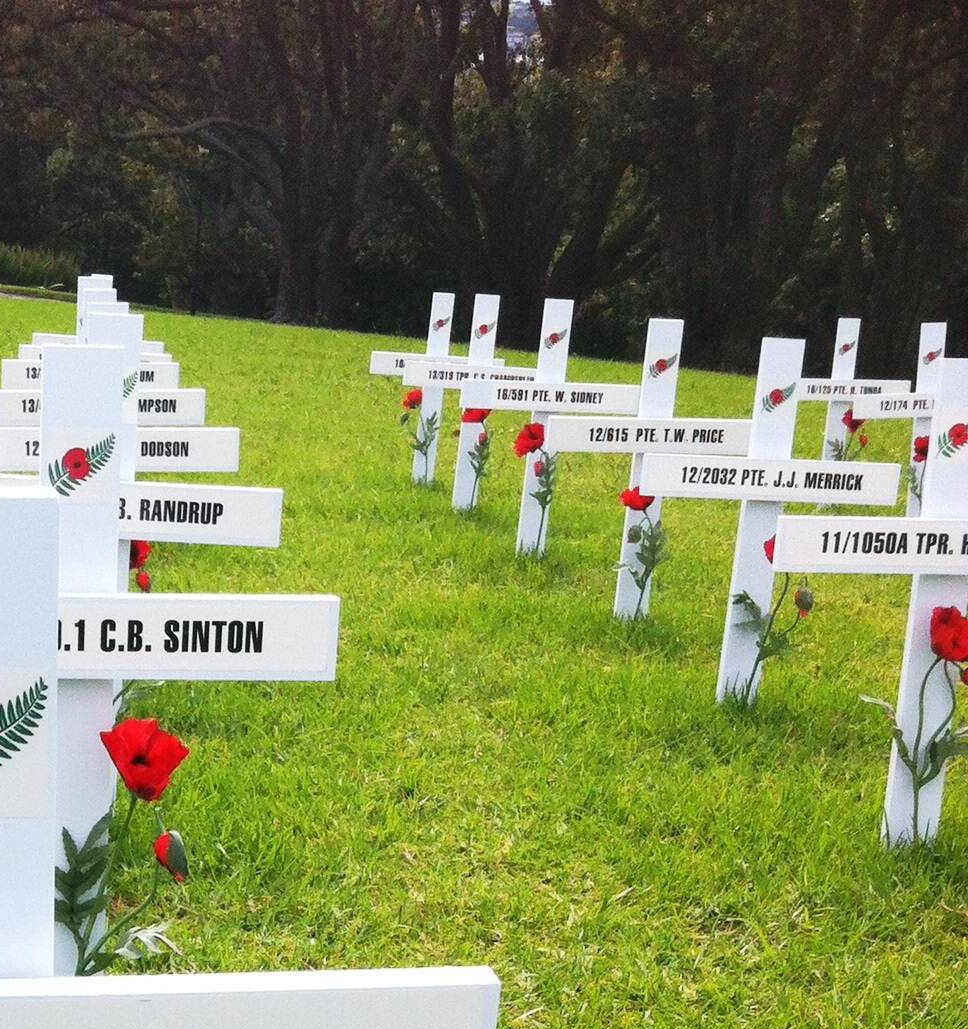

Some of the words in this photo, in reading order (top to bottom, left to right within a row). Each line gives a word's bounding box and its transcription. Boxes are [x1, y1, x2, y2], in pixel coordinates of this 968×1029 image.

[140, 370, 154, 382] UM
[532, 390, 551, 402] PTE.
[555, 391, 566, 403] W.
[570, 392, 604, 404] SIDNEY
[138, 398, 177, 414] MPSON
[880, 400, 908, 412] 12/174
[912, 400, 930, 410] PTE.
[588, 427, 628, 443] 12/615
[635, 428, 659, 444] PTE.
[664, 428, 689, 444] T.W.
[692, 428, 724, 444] PRICE
[24, 440, 40, 456] 12
[140, 441, 189, 457] DODSON
[681, 466, 736, 486] 12/2032
[740, 468, 768, 488] PTE.
[773, 470, 800, 490] J.J.
[804, 471, 864, 492] MERRICK
[139, 499, 224, 526] RANDRUP
[821, 531, 908, 554] 11/1050A
[916, 532, 954, 555] TPR.
[100, 619, 152, 653] C.B.
[164, 619, 264, 653] SINTON
